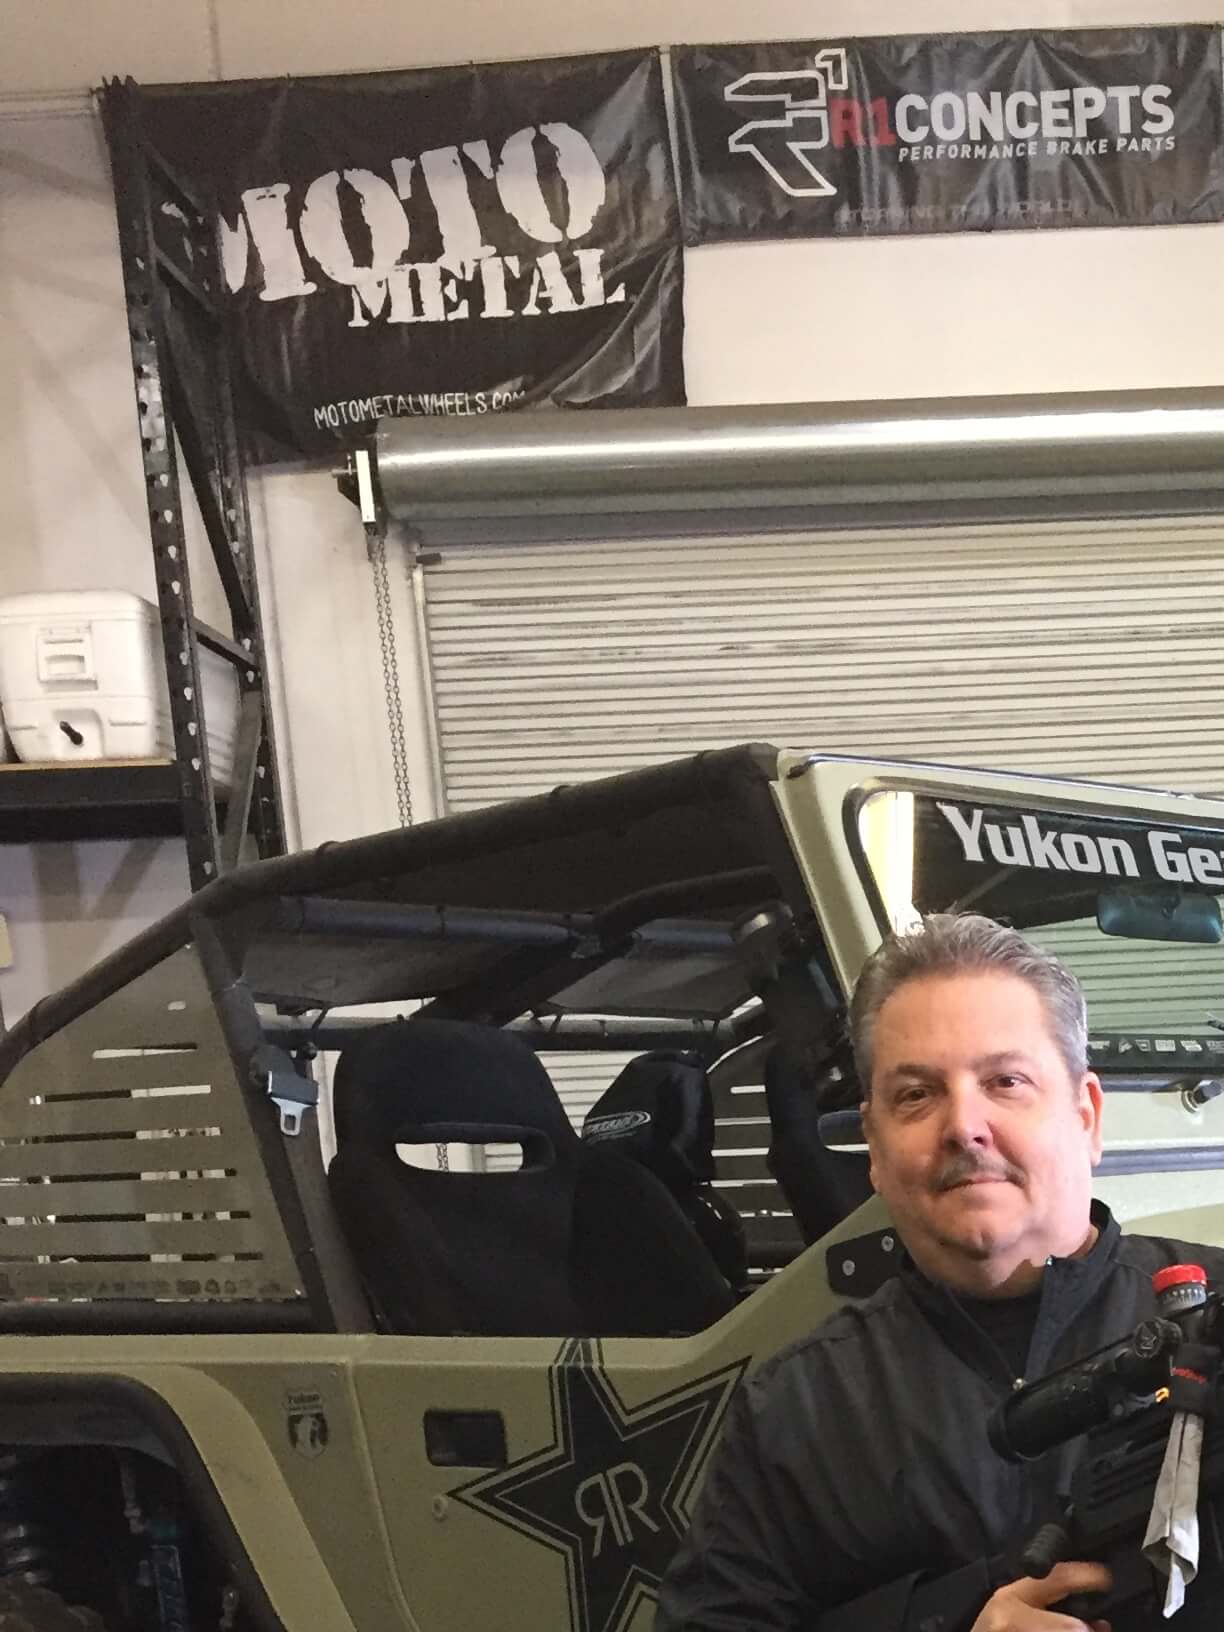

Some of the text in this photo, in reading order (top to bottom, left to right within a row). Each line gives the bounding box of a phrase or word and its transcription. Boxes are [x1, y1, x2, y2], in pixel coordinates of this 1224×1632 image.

[898, 135, 1176, 162] PERFORMANCE BRAKE PARTS
[347, 248, 626, 328] METAL
[313, 390, 526, 429] MOTOMETALWHEELSCO
[936, 801, 1142, 880] Yukon
